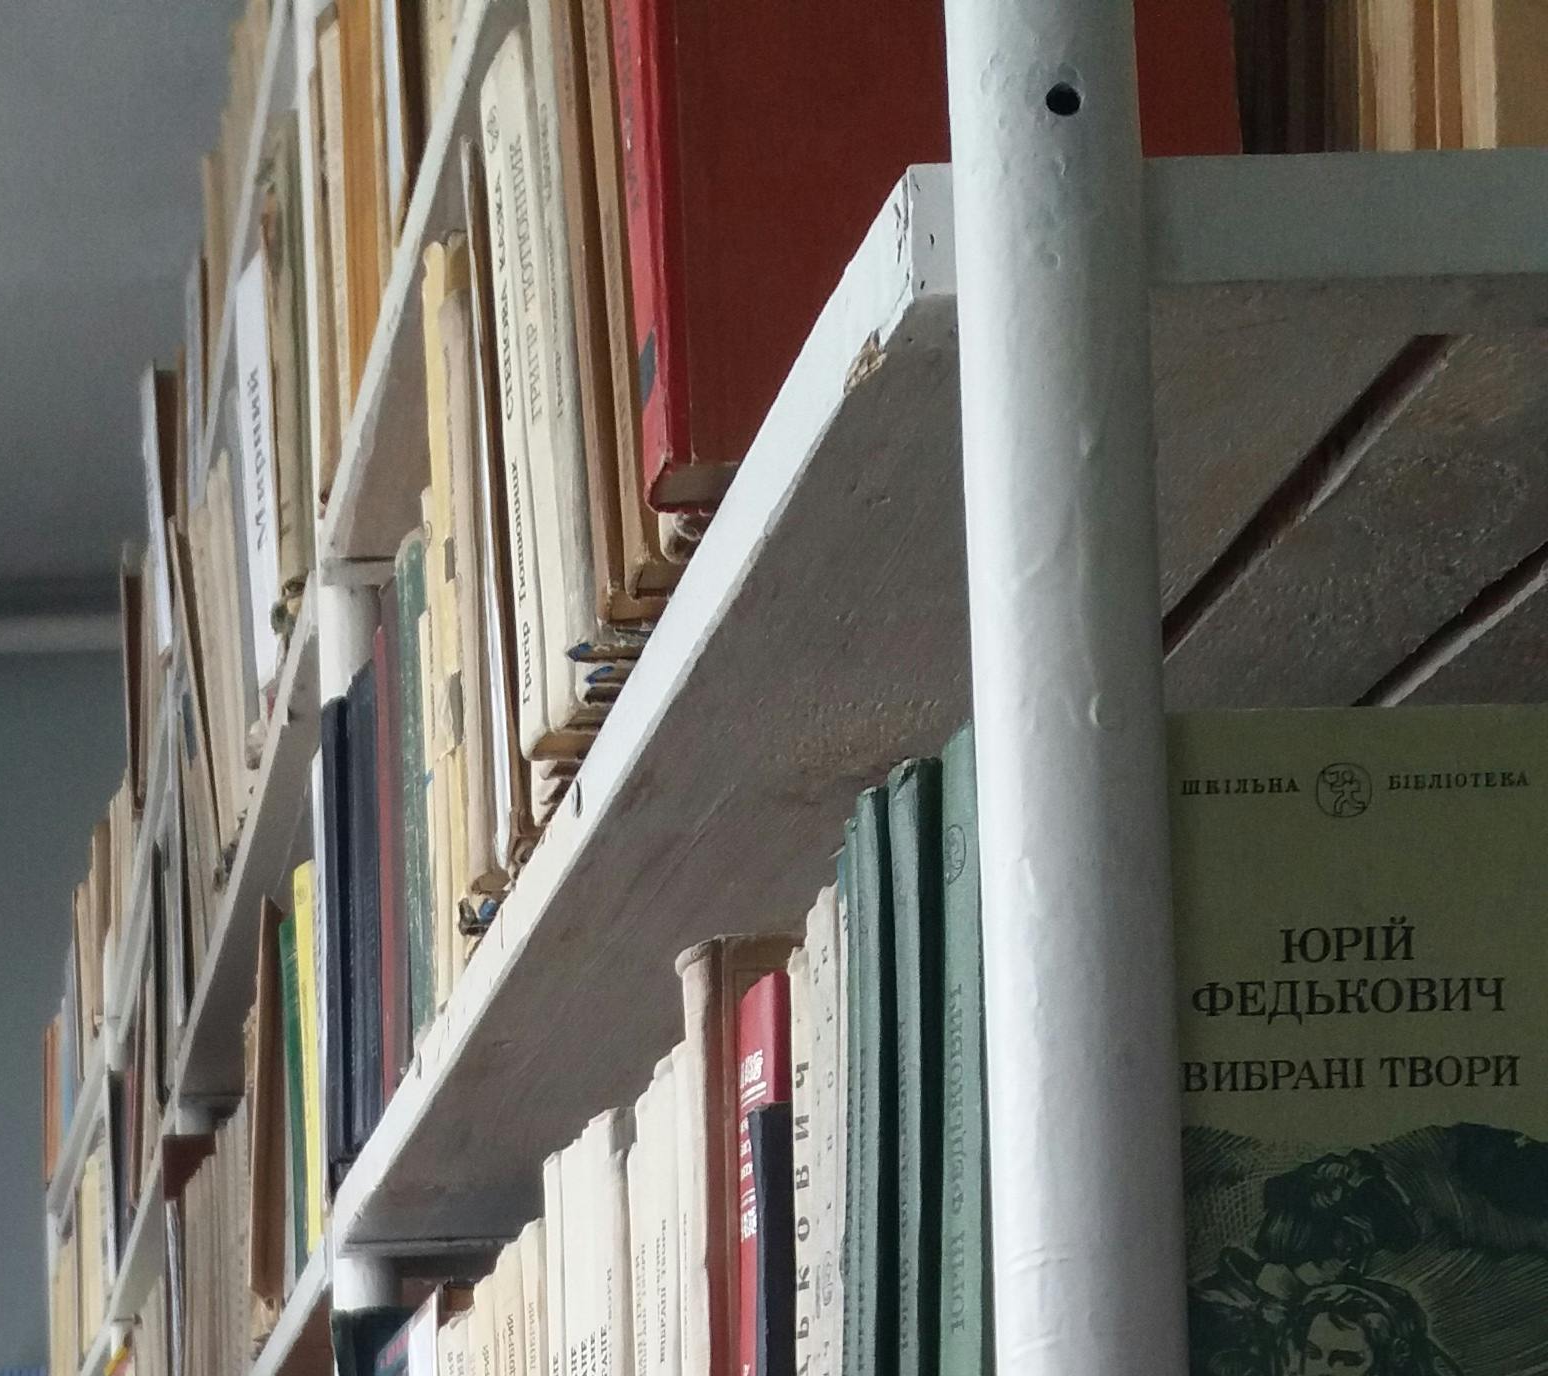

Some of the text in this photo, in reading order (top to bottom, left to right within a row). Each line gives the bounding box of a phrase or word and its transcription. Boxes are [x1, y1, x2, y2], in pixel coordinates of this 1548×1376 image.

[494, 169, 514, 421] СТЕПОВА КАЗКА
[509, 134, 542, 423] ГРИГІР ТЮТЮННИК
[247, 366, 266, 552] Мирний
[510, 457, 531, 705] Григір Тютюнник
[1181, 771, 1530, 796] ШКІЛЬНА БІБЛІОТЕКА
[1191, 977, 1505, 1025] ФЕДЬКОВИЧ
[1280, 916, 1416, 964] ЮРІЙ
[1182, 1054, 1520, 1093] ВИБРАНІ ТВОРИ
[948, 983, 967, 1335] ЮРІЙ ФЕДЬКОВИЧ
[528, 1300, 536, 1371] ДОБРИЙ
